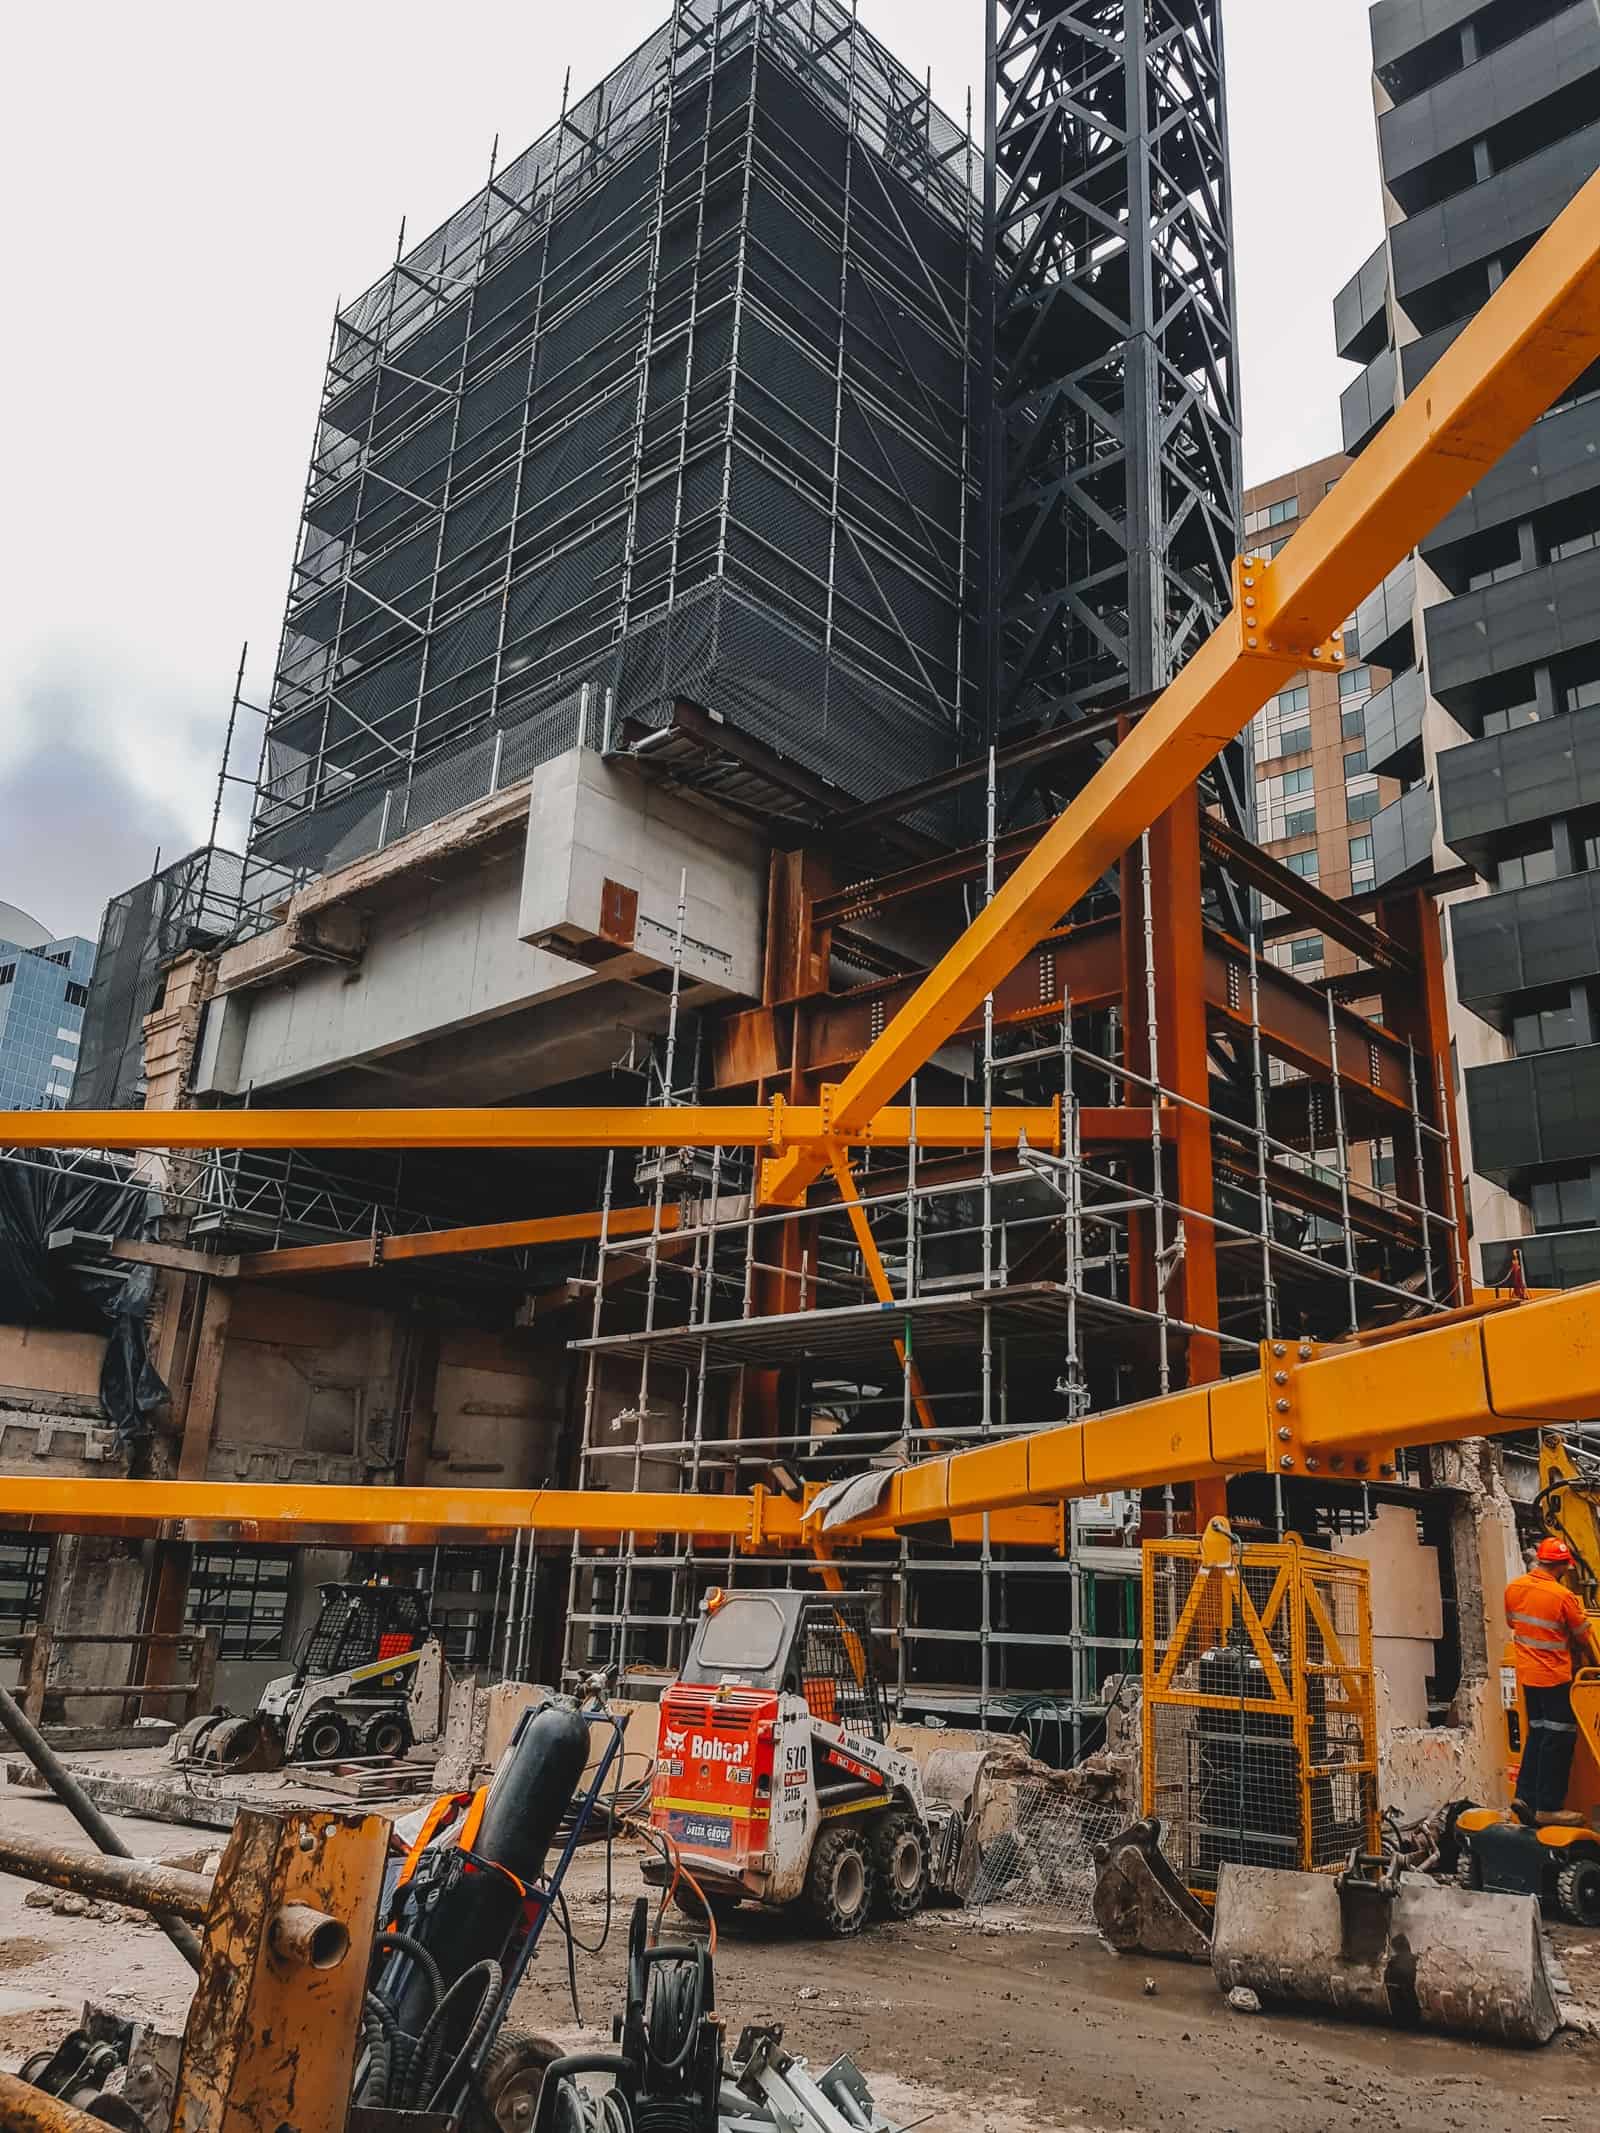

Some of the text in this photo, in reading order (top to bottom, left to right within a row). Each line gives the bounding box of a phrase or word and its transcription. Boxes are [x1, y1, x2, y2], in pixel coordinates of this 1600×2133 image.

[786, 1745, 807, 1770] S70
[686, 1823, 730, 1840] DELTA GROUP
